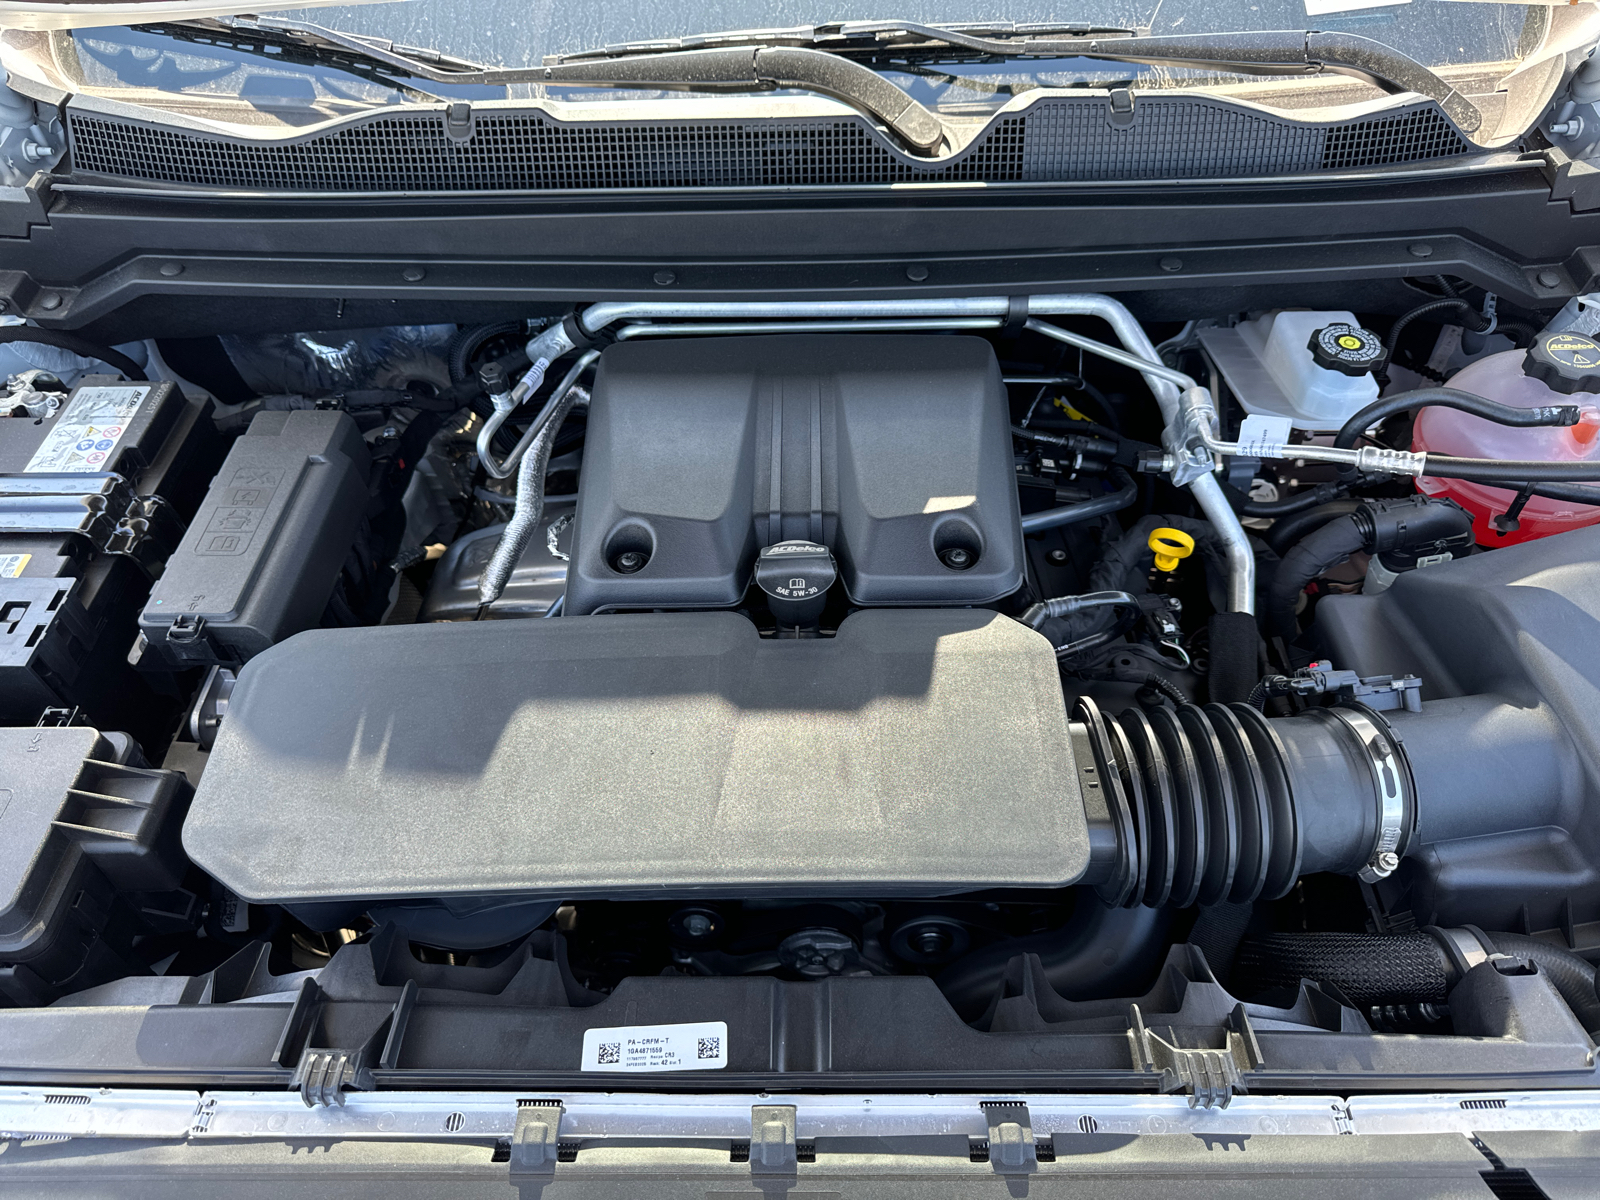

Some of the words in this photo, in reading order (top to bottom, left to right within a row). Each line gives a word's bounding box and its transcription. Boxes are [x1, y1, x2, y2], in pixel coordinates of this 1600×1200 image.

[1549, 343, 1595, 351] ACDelco
[766, 545, 825, 555] ACDelco
[775, 586, 790, 596] SAE
[792, 586, 818, 597] 5W-30
